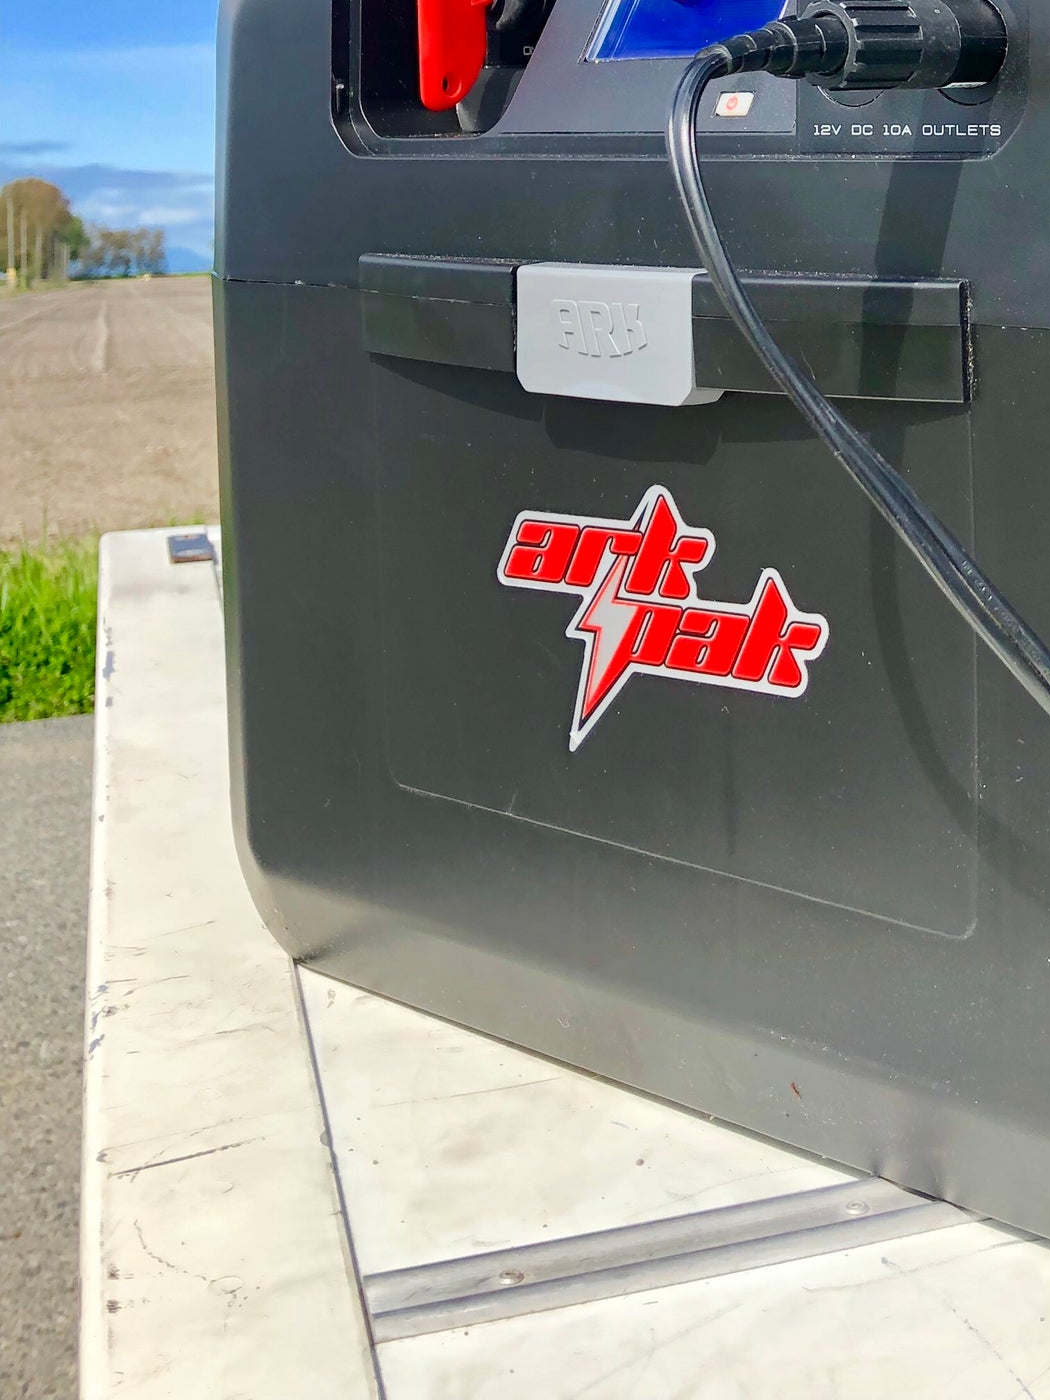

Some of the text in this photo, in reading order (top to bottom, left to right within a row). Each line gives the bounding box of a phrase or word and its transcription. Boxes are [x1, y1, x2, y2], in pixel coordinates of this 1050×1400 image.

[813, 125, 1001, 136] 12V DC 10A OUTLETS
[552, 299, 648, 358] ARK
[503, 494, 709, 600] ark
